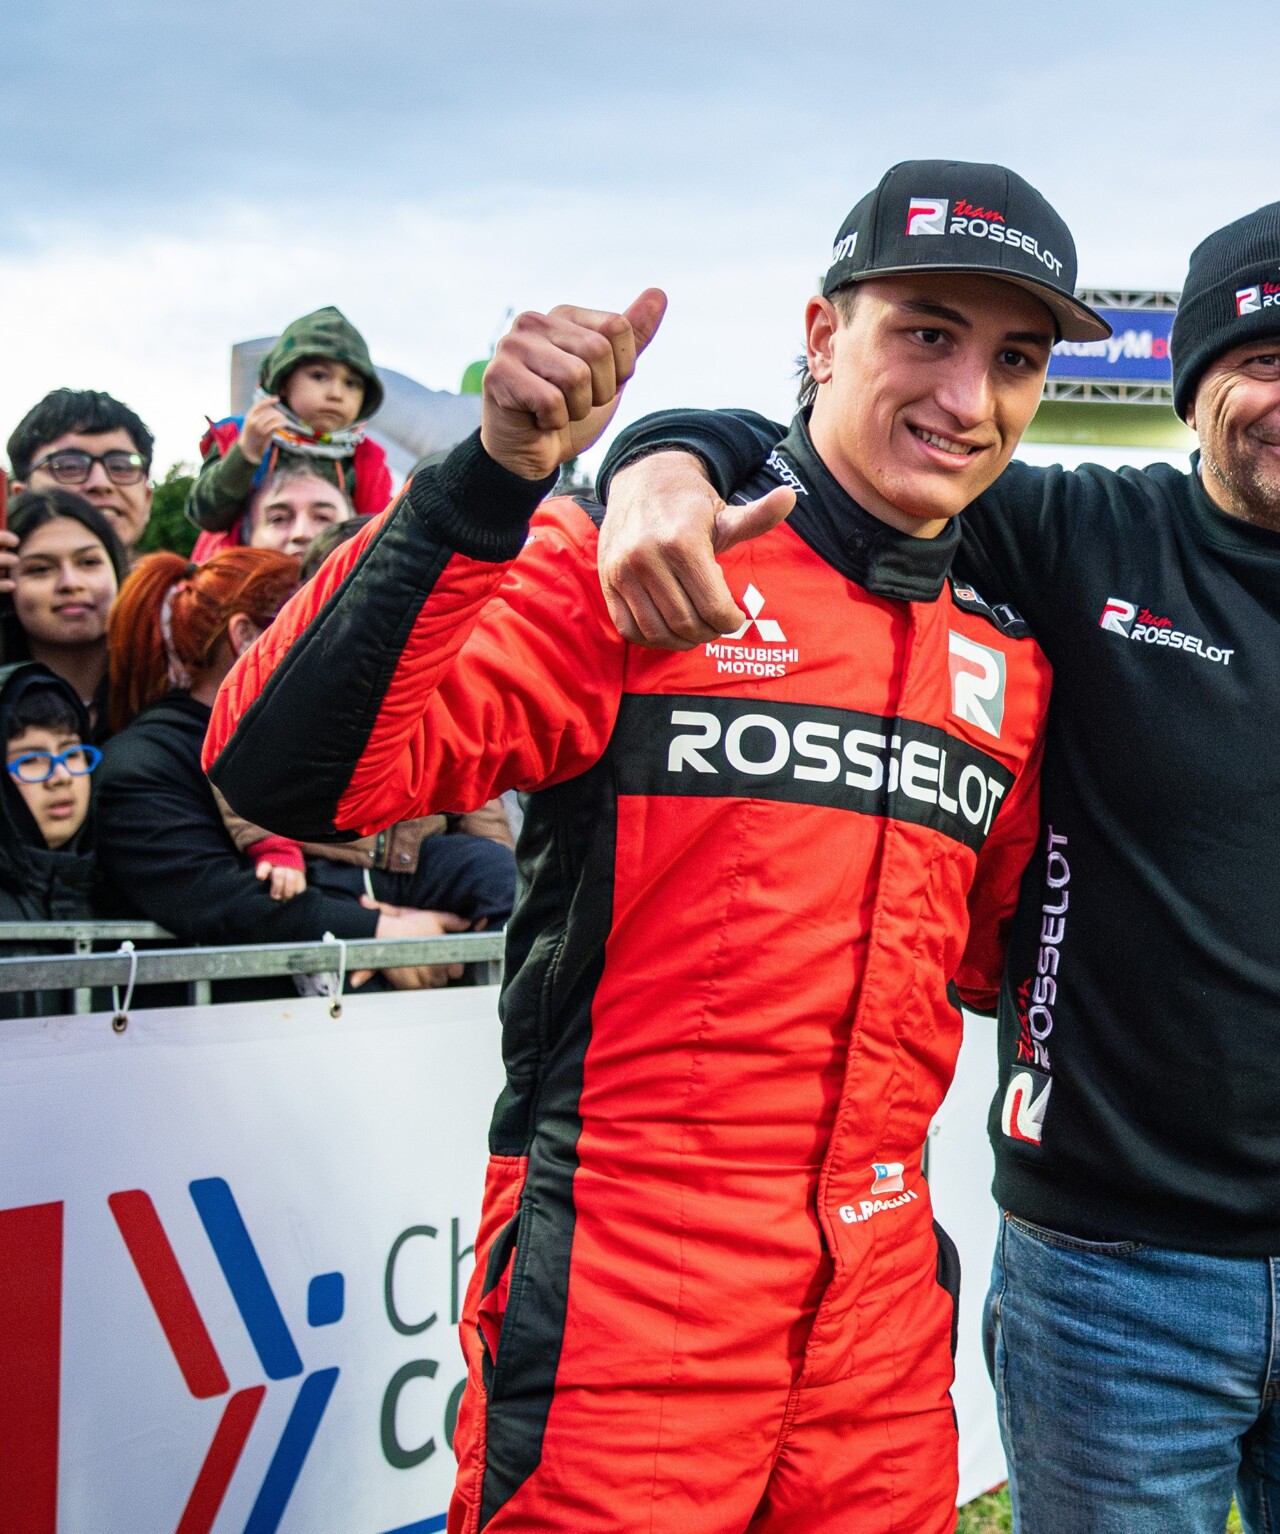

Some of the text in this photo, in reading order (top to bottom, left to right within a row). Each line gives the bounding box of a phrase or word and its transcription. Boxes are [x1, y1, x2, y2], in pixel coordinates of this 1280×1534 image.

[952, 199, 1005, 223] team
[950, 216, 1063, 277] ROSSELOT
[1138, 608, 1172, 628] team
[705, 642, 799, 663] MITSUBISHI
[1130, 623, 1234, 665] ROSSELOT
[717, 660, 786, 678] MOTORS
[667, 710, 1005, 836] ROSSELOT
[1028, 824, 1071, 1069] ROSSELOT
